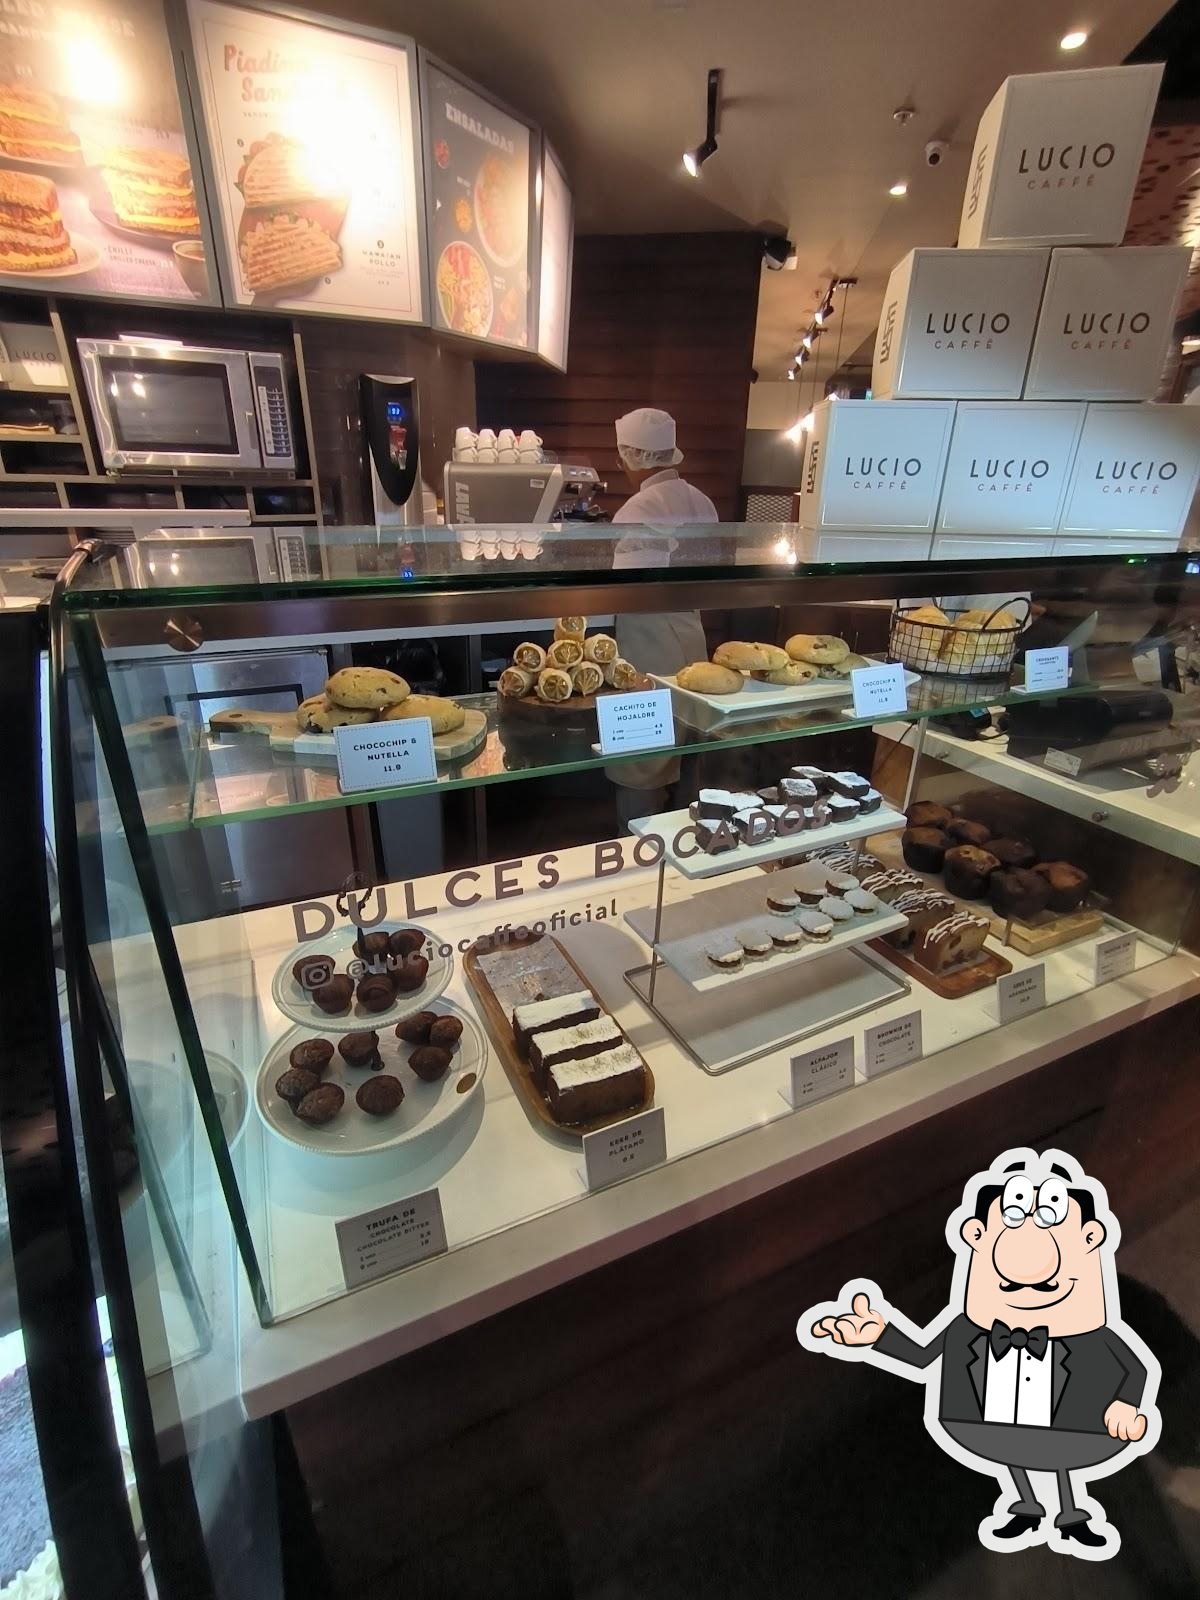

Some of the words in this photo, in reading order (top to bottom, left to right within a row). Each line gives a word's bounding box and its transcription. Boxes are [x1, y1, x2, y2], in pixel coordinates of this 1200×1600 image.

[1019, 143, 1115, 173] LUCIO
[926, 313, 1010, 334] LUCIO
[1063, 312, 1150, 334] LUCIO
[15, 351, 57, 362] LUCIO
[845, 457, 922, 476] LUCIO
[970, 459, 1049, 478] LUCIO
[1095, 461, 1177, 480] LUCIO
[613, 703, 645, 712] CACHITO
[617, 711, 656, 721] HOJALDRE
[353, 739, 407, 751] CHOCOCHIP
[367, 750, 410, 761] NUTELLA
[292, 854, 560, 943] DULCES
[595, 800, 832, 878] BOCADOS
[366, 1214, 399, 1230] TRUFA
[402, 1208, 415, 1218] DE
[370, 1218, 415, 1238] CHOCOLATE
[356, 1230, 402, 1252] CHOCOLATE
